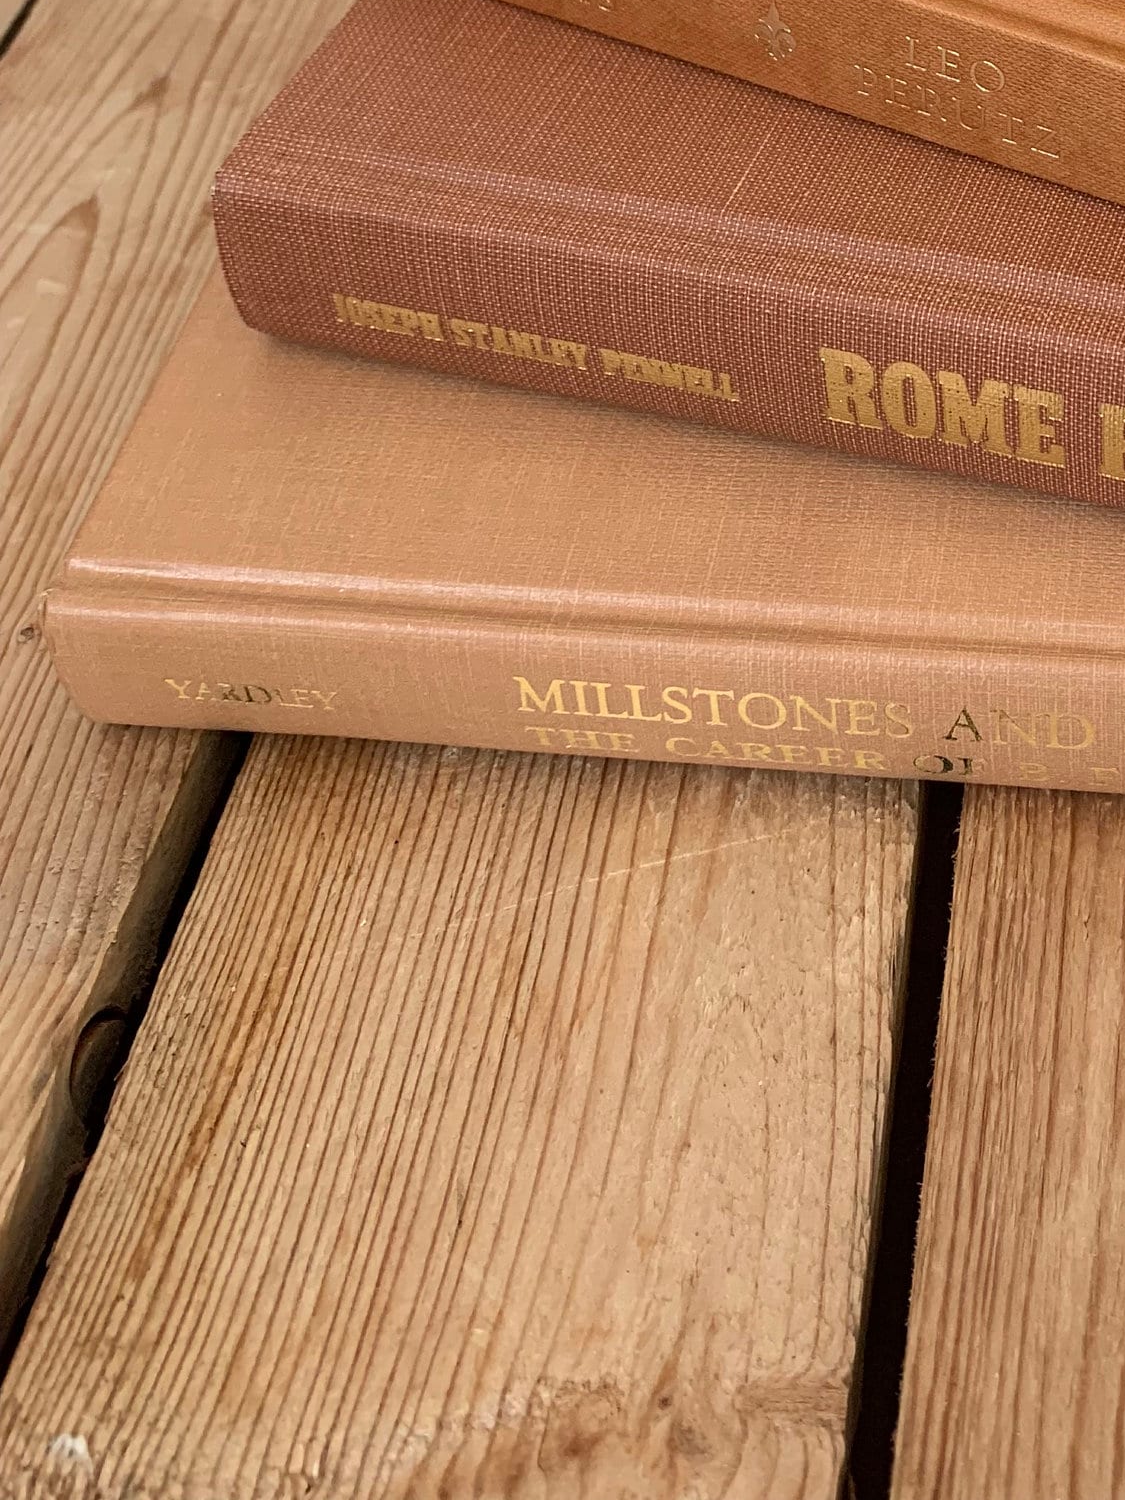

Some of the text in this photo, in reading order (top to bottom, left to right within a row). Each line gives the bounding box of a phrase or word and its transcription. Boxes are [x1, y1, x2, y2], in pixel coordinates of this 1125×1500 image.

[905, 35, 1005, 93] LEO
[854, 64, 1060, 159] PERUTZ
[332, 293, 442, 343] JOSEPH
[450, 318, 588, 371] STANLEY
[819, 346, 1066, 469] ROME
[164, 678, 337, 710] YARDLEY
[513, 676, 912, 739] MILLSTONES
[942, 704, 1096, 751] AND
[525, 726, 640, 754] THE
[665, 736, 888, 771] CAREER
[912, 754, 987, 778] OF
